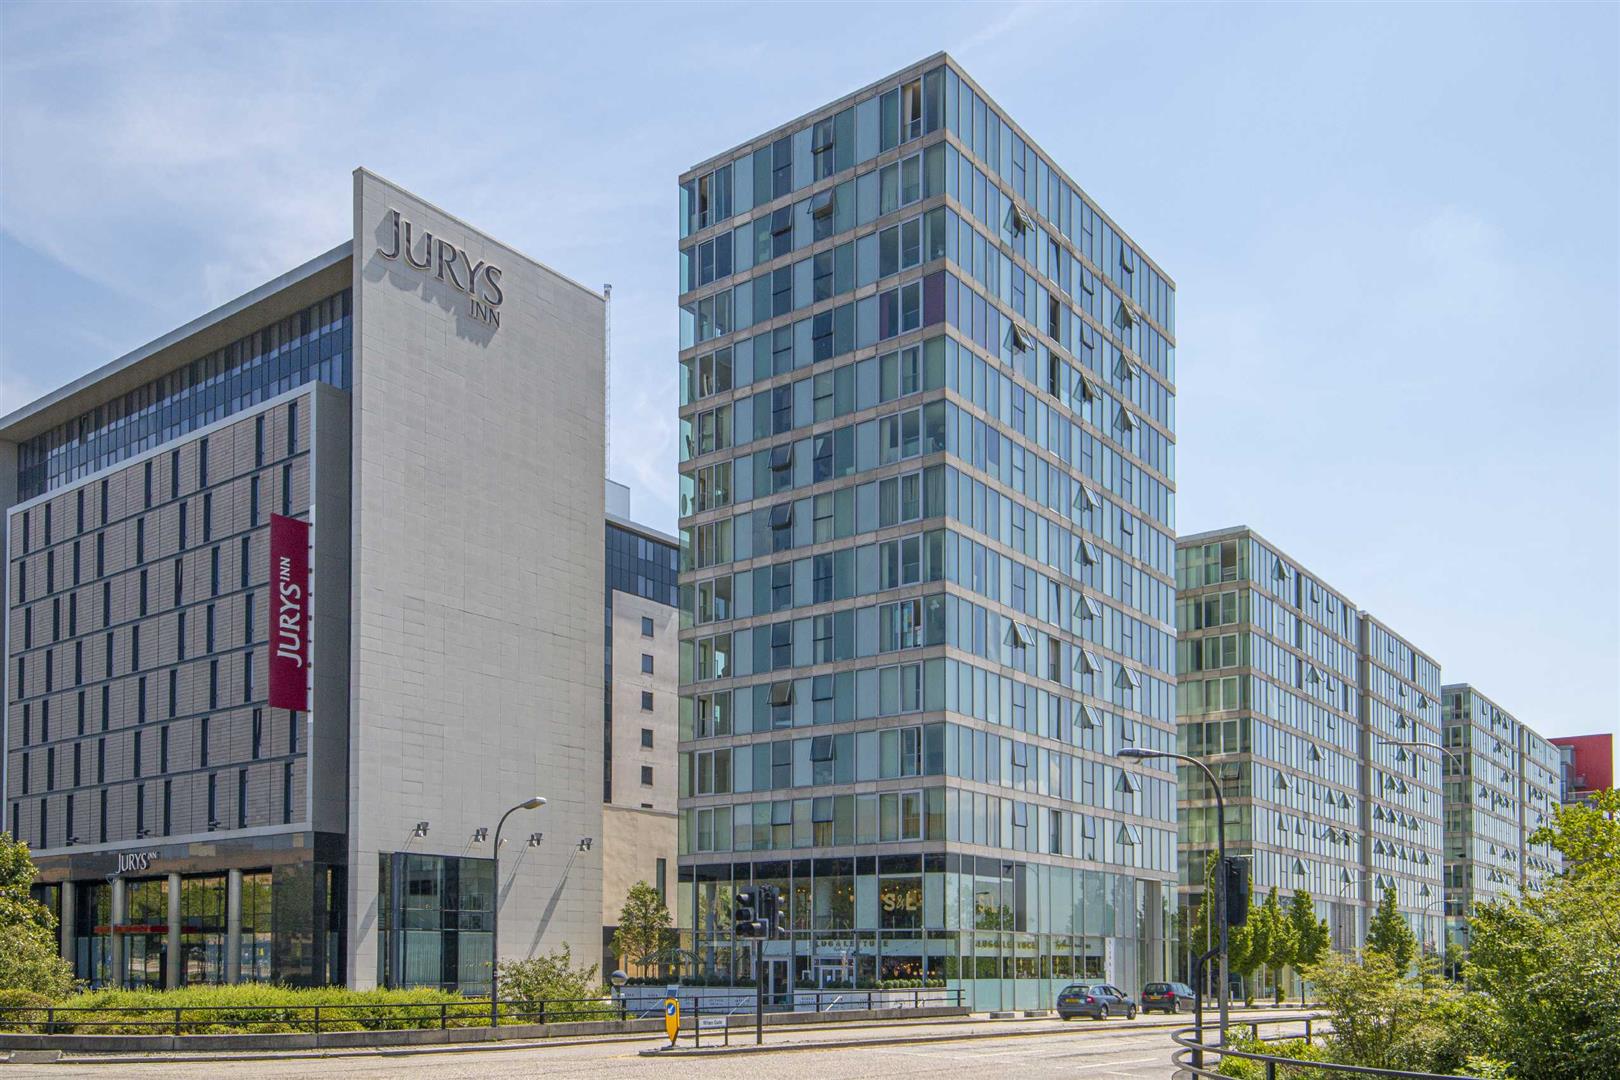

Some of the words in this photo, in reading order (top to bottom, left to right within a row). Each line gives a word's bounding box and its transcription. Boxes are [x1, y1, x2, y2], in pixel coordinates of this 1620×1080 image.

[376, 209, 504, 308] JURYS
[469, 300, 501, 329] INN
[279, 556, 292, 582] INN
[276, 582, 303, 668] JURYS
[115, 852, 148, 875] JURYS
